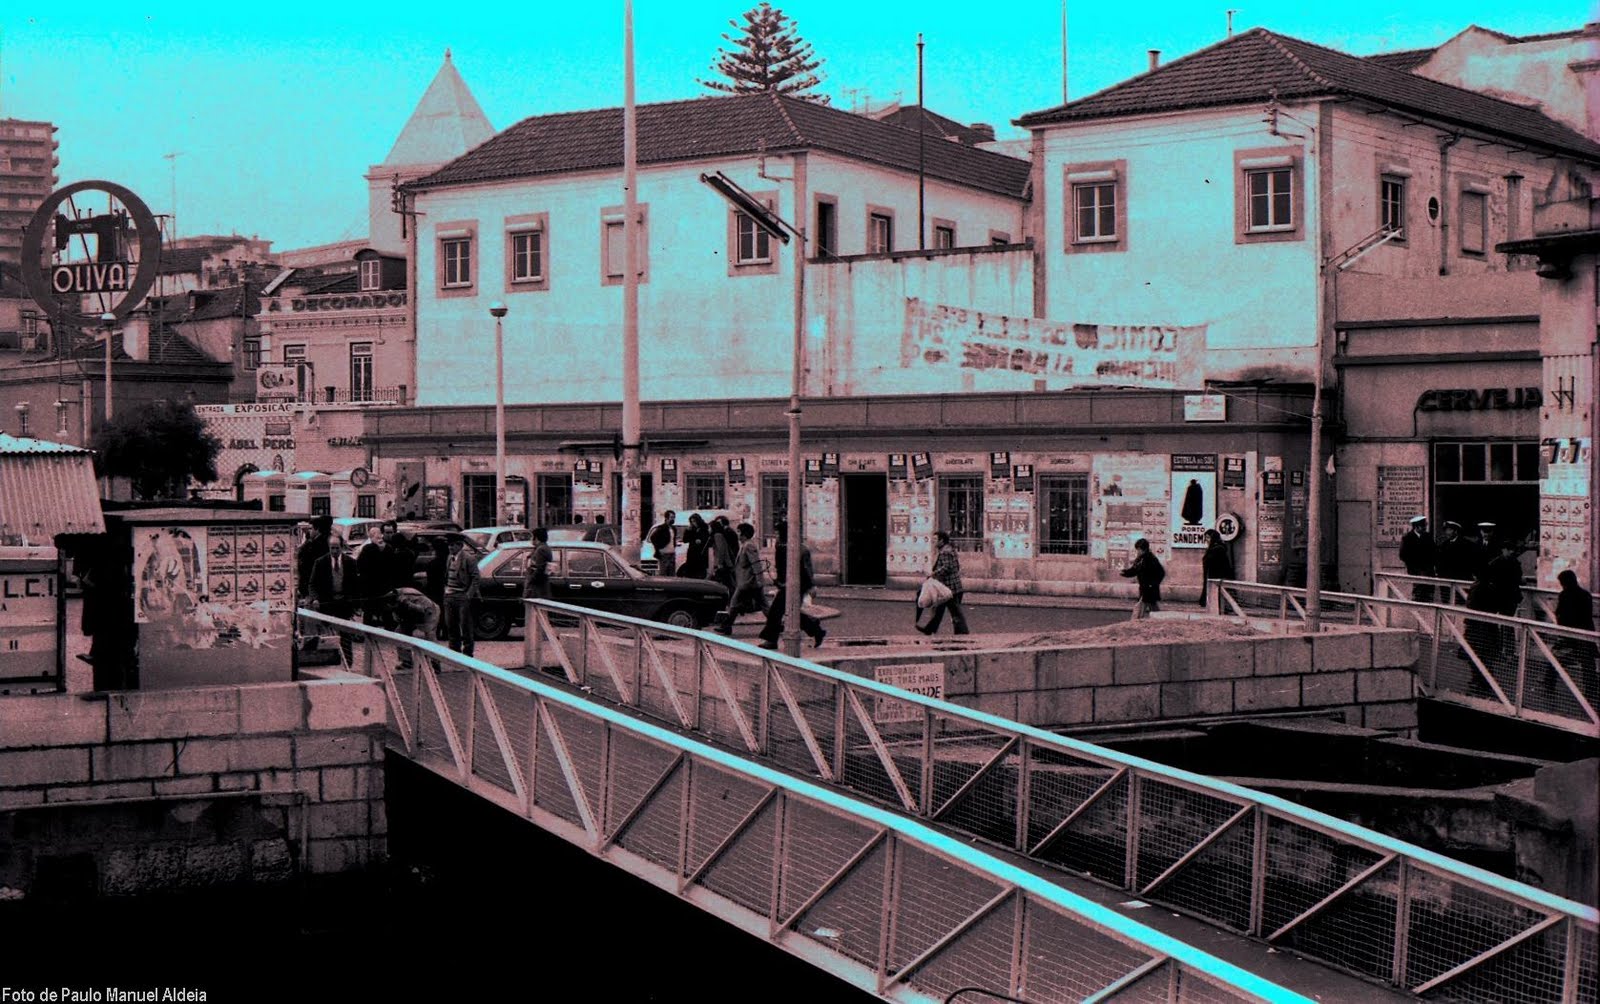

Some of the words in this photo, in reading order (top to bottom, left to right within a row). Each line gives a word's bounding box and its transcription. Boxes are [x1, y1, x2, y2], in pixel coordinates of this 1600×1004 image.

[53, 262, 127, 293] OLIVA
[292, 292, 408, 313] DECORADO
[4, 577, 58, 599] L.C.I.
